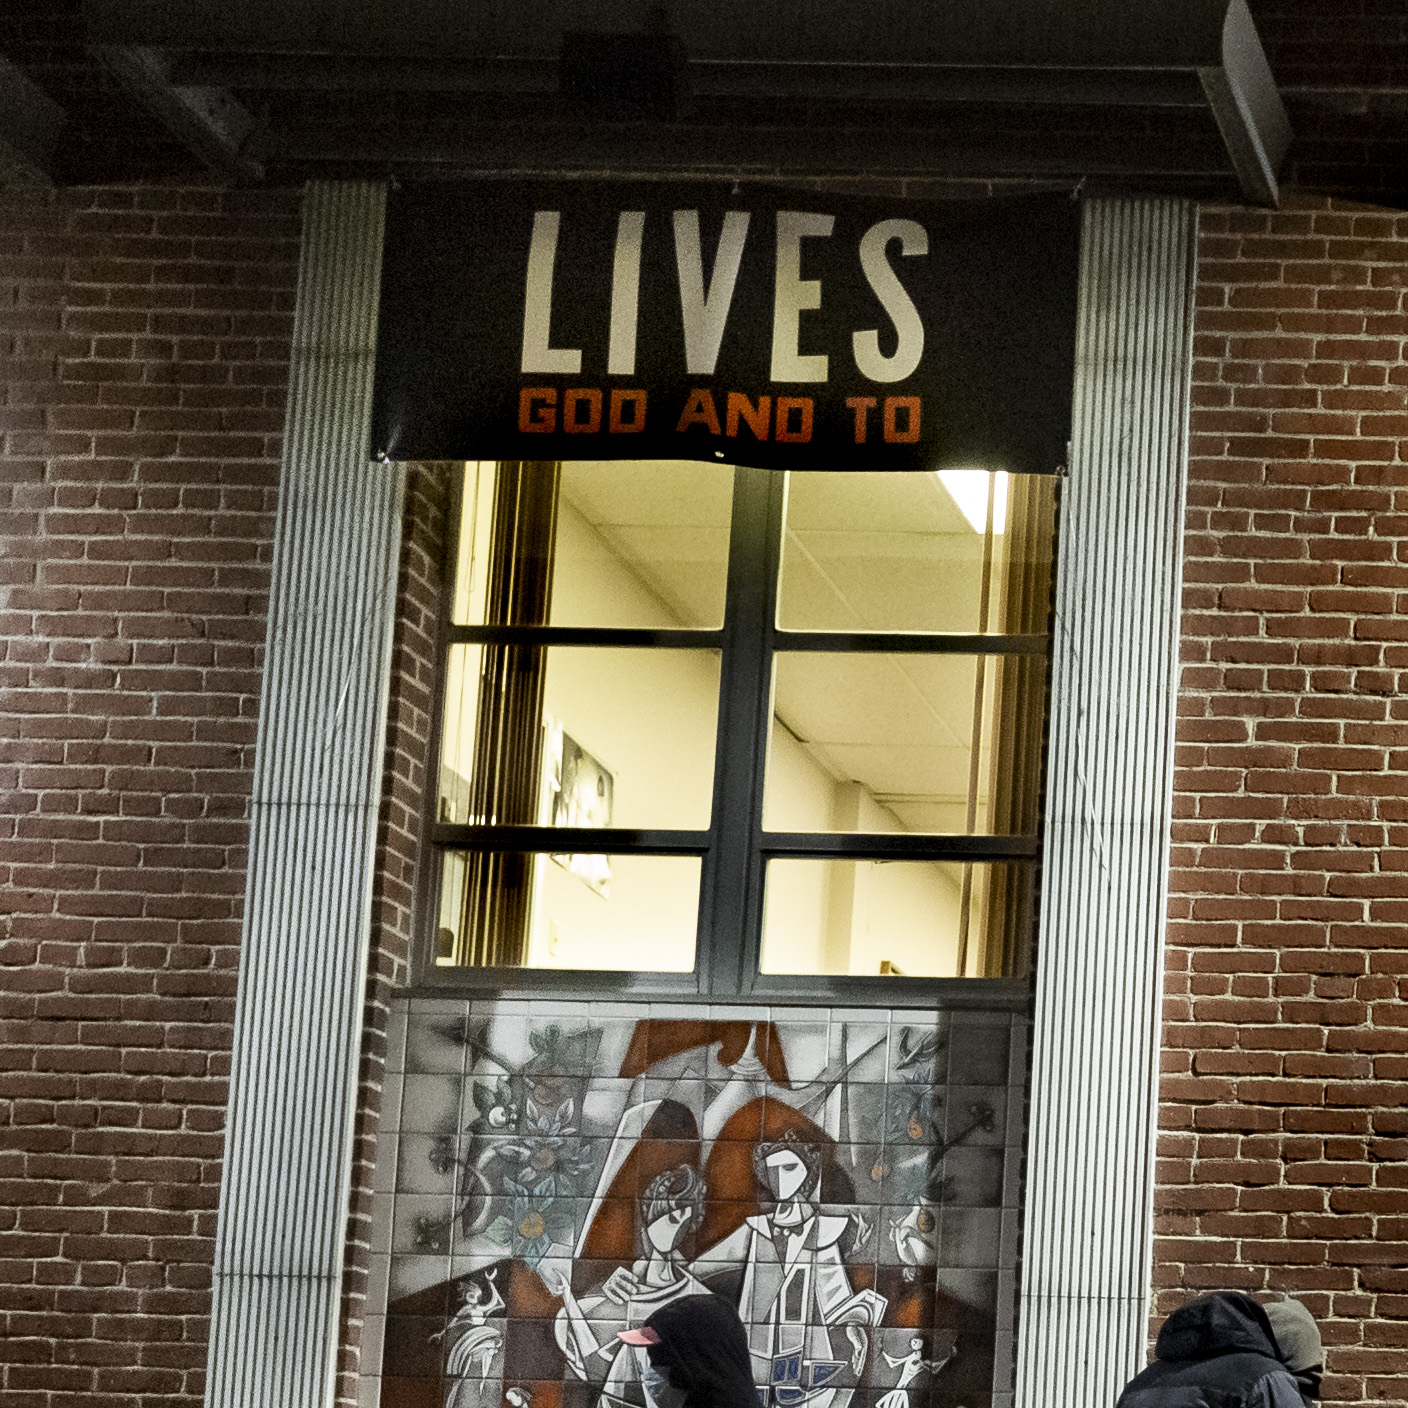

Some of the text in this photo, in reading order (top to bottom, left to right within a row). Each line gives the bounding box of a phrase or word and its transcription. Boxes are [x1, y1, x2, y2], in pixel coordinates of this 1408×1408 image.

[520, 210, 929, 383] LIVES
[518, 388, 922, 444] GOD AND TO
